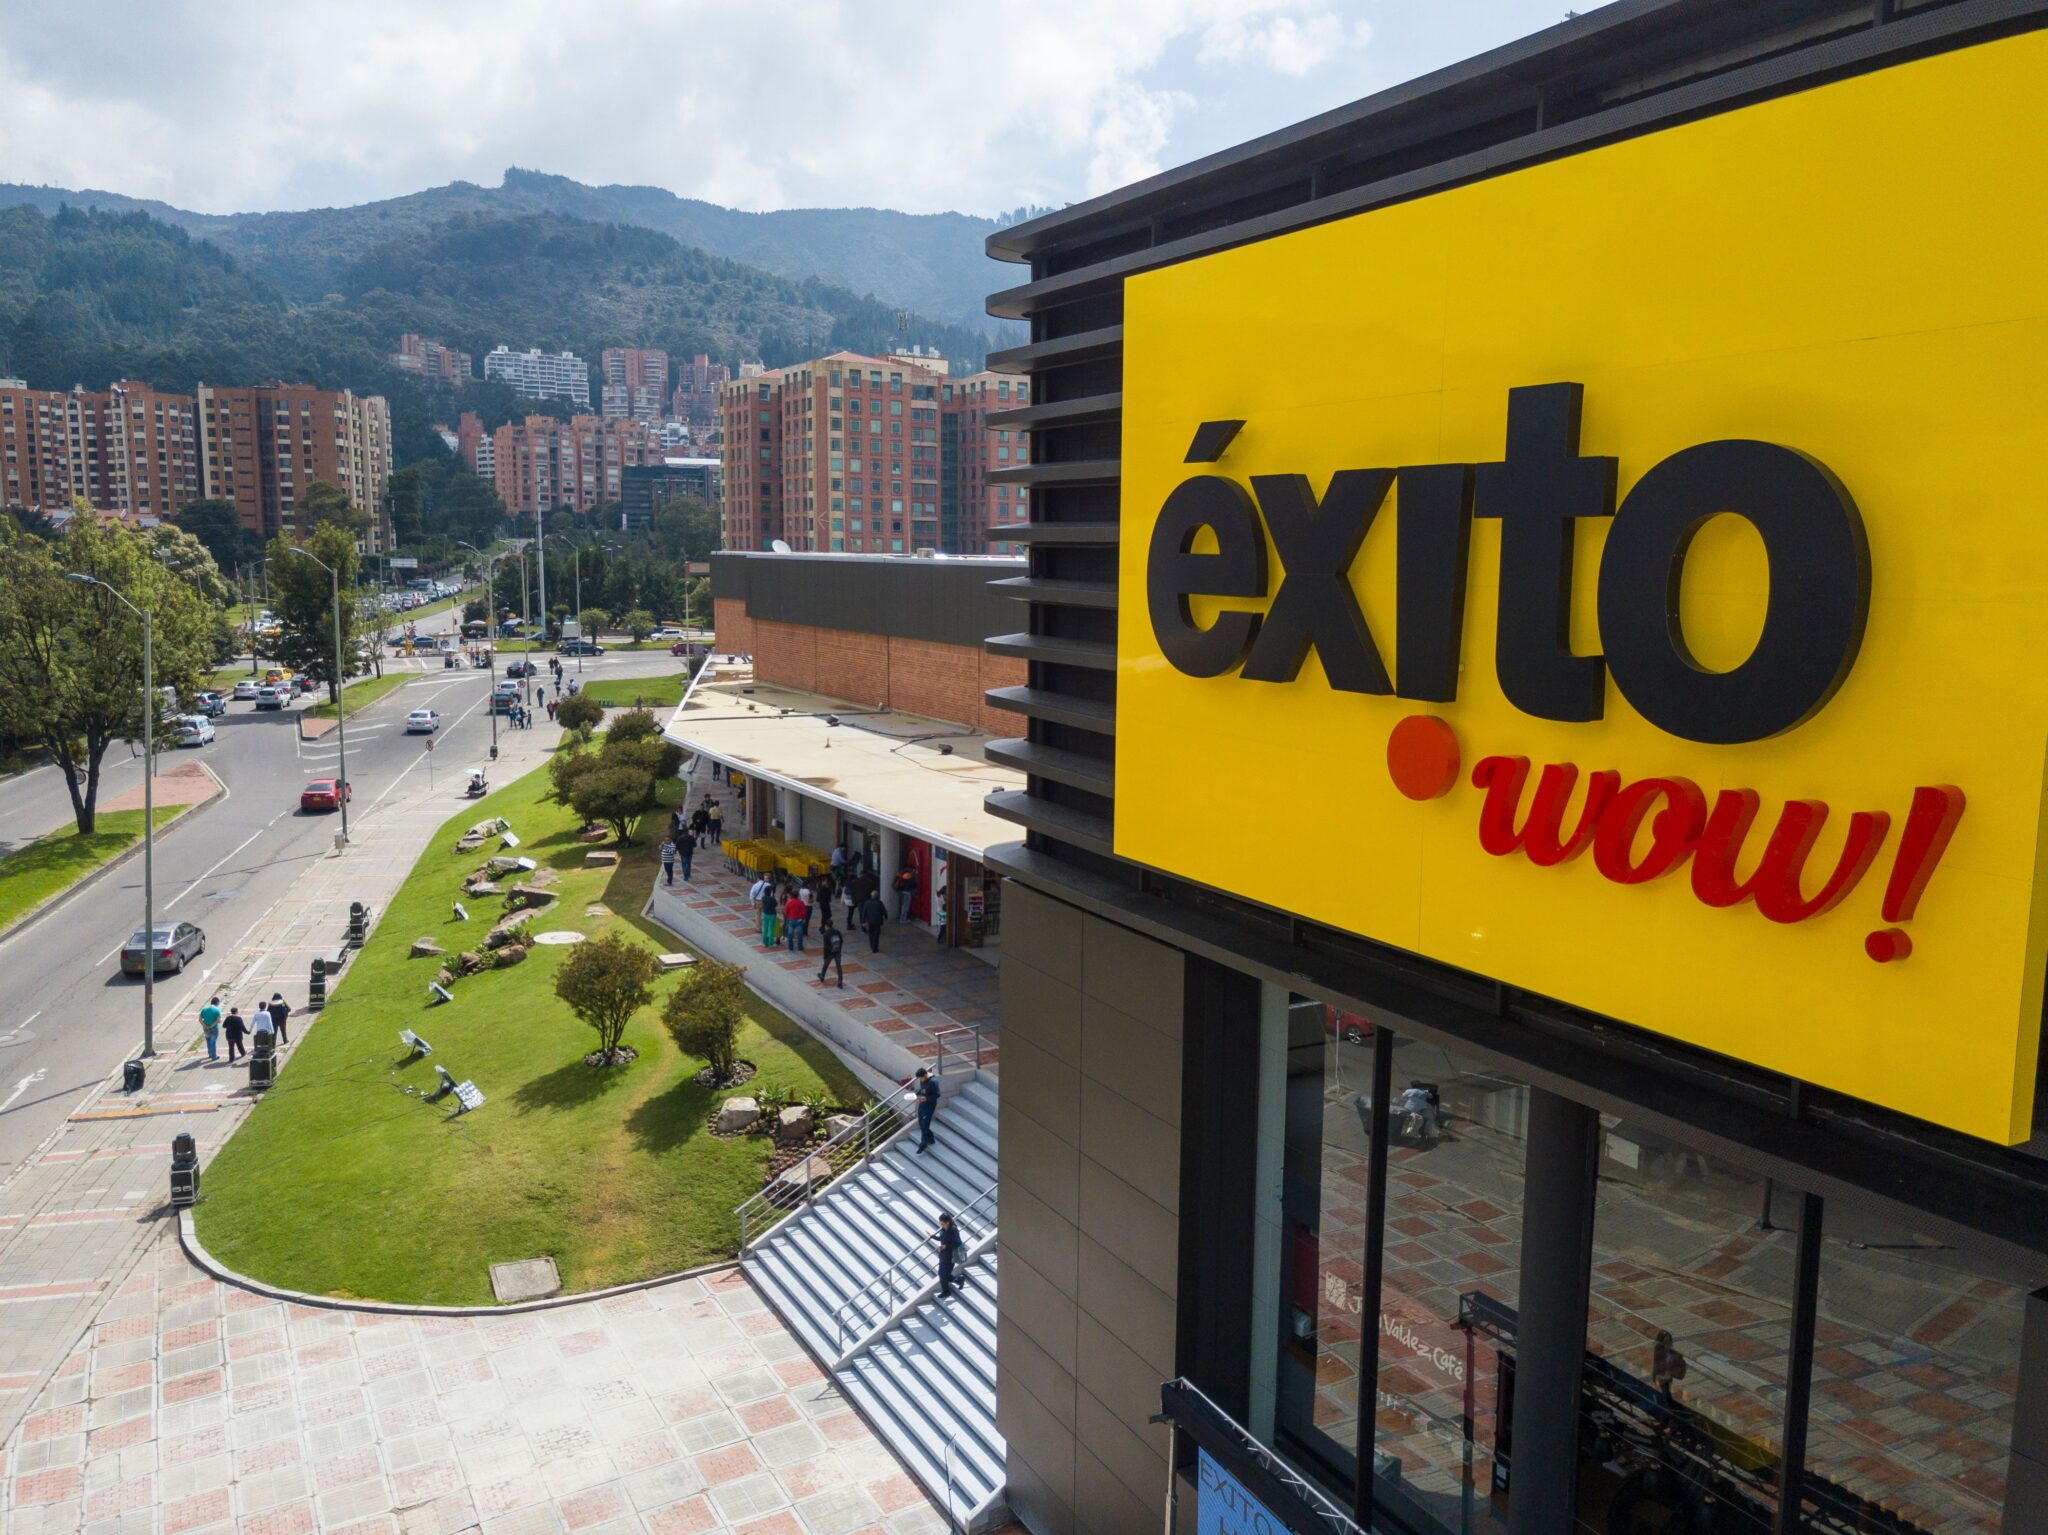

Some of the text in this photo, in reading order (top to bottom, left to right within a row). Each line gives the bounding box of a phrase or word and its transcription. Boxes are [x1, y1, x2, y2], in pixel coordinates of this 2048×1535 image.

[1147, 381, 1872, 745] éxito
[1471, 754, 1966, 964] wow!
[1383, 1314, 1464, 1381] Valdez Café
